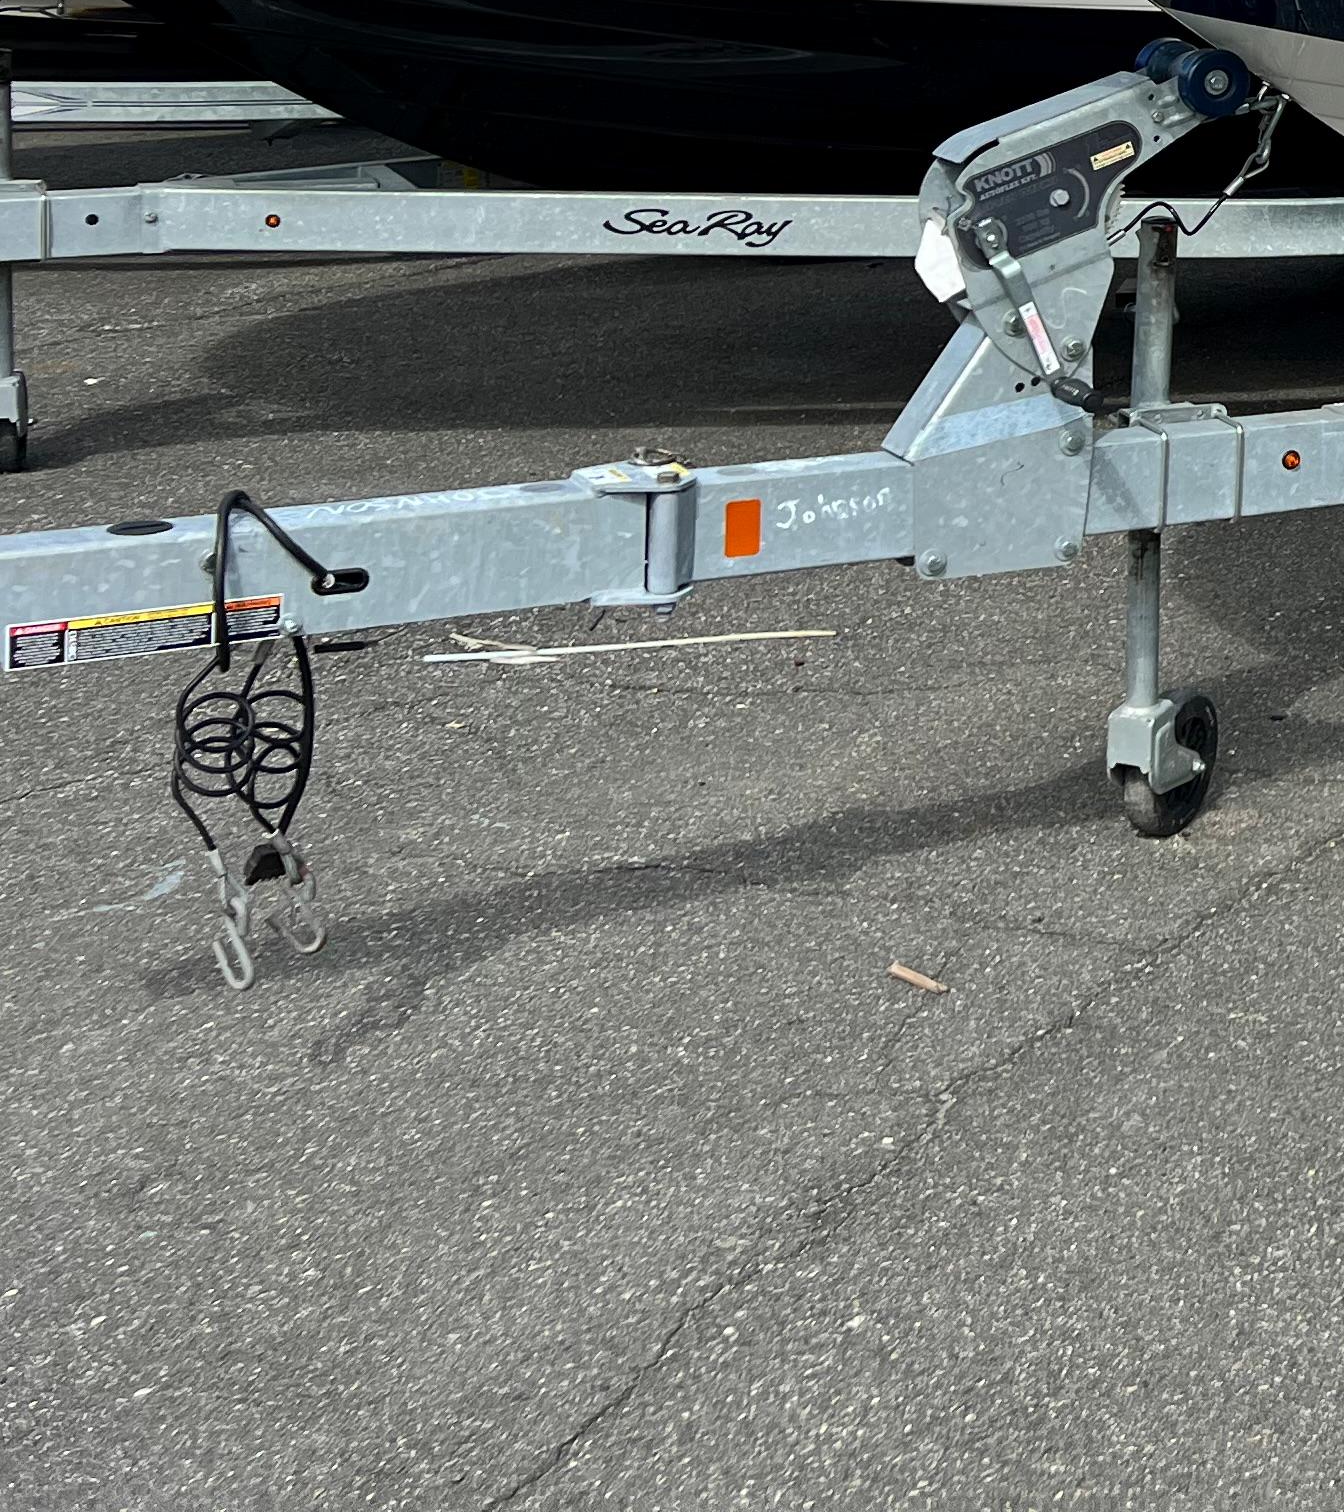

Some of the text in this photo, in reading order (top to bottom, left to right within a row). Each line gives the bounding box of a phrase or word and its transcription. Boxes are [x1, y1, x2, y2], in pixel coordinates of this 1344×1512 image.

[974, 158, 1034, 193] KNOTT
[602, 208, 794, 248] Sea Ray
